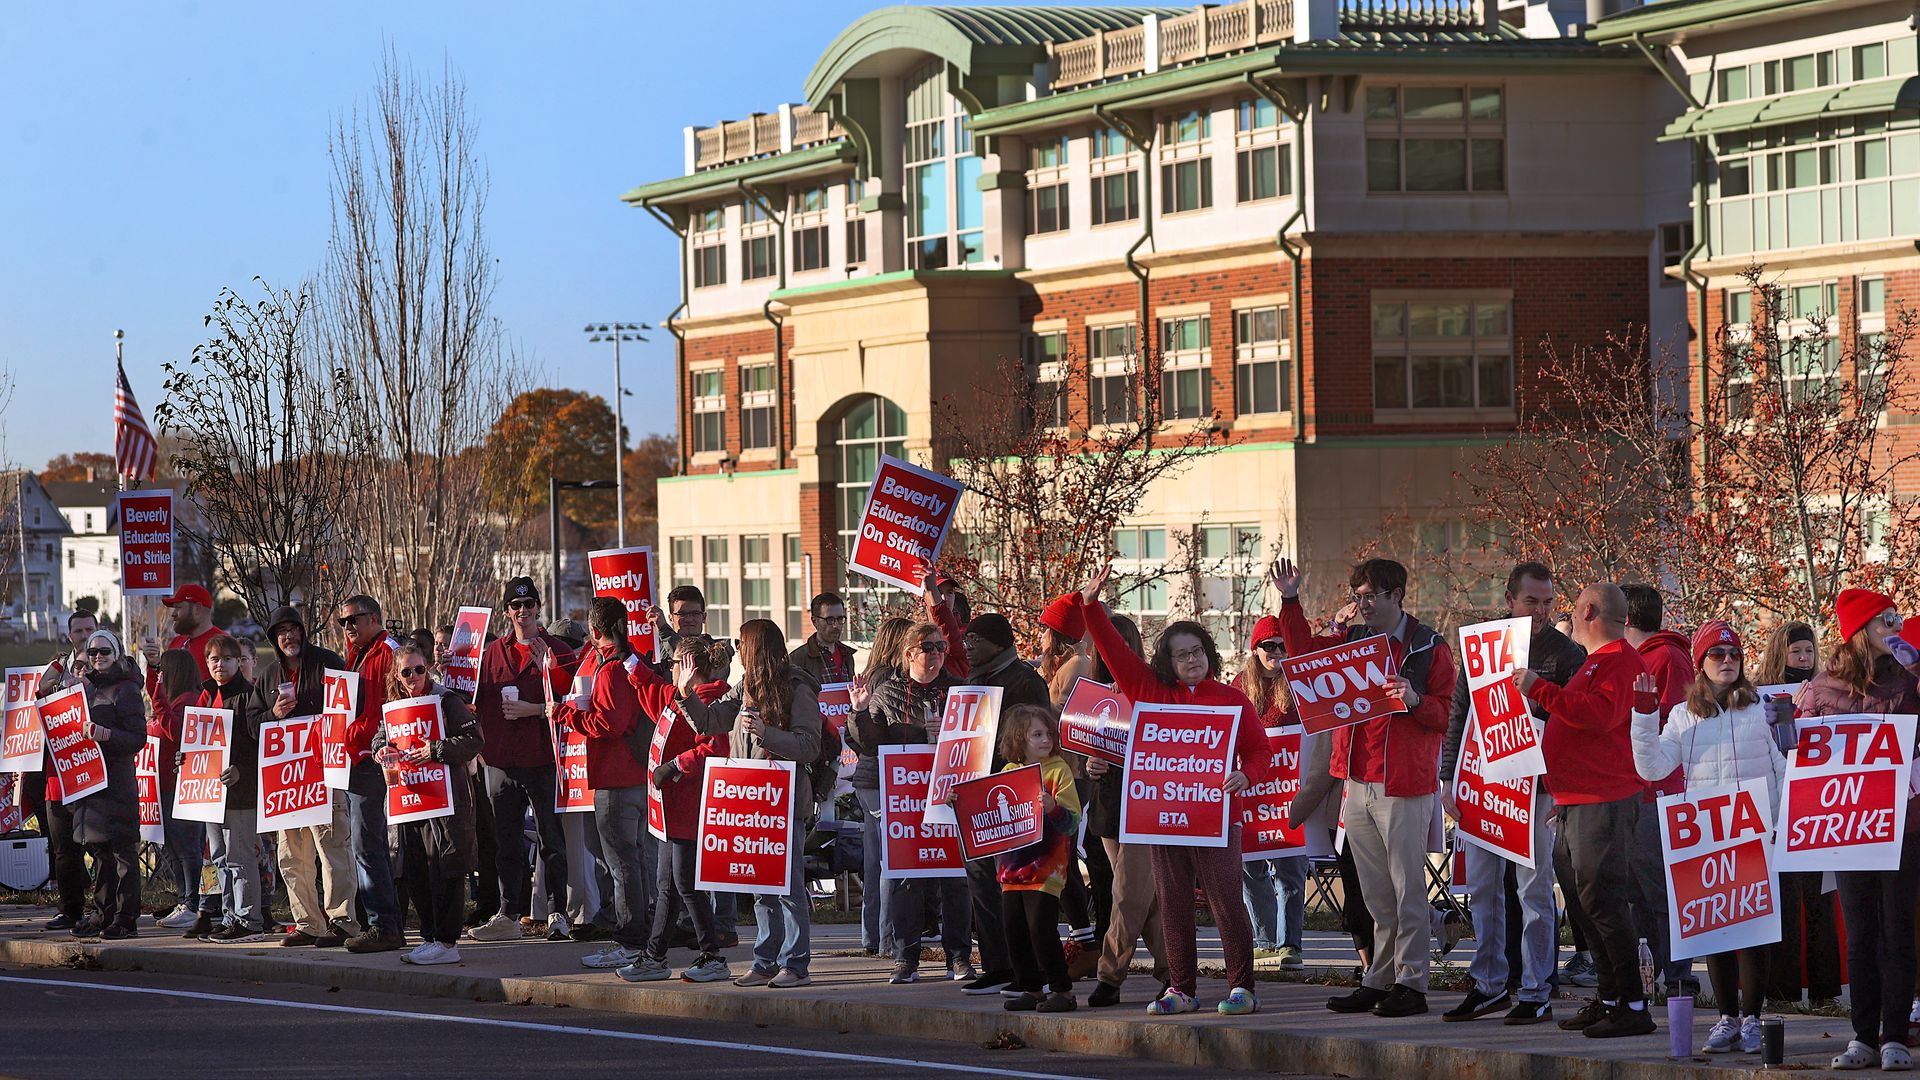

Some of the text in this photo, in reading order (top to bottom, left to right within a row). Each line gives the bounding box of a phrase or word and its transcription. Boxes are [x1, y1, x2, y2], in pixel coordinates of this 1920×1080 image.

[881, 476, 948, 517] Beverly
[125, 507, 168, 525] Beverly
[869, 499, 940, 538] Educators
[124, 530, 170, 545] Educators
[863, 523, 931, 559] On Strike
[125, 550, 170, 565] On Strike
[880, 554, 902, 570] BTA
[143, 572, 158, 580] BTA
[595, 570, 643, 591] Beverly
[627, 620, 652, 636] ike
[452, 653, 478, 668] ducators
[1291, 643, 1380, 674] LIVING WAGE
[1464, 628, 1519, 678] BTA
[326, 675, 351, 710] TA
[445, 674, 476, 691] On Strike
[1290, 656, 1390, 706] NOW
[819, 702, 852, 717] Beve
[1488, 682, 1509, 717] ON
[15, 709, 31, 730] ON
[45, 705, 81, 731] Beverly
[943, 694, 991, 731] BTA
[184, 713, 226, 747] BTA
[387, 717, 432, 740] Beverly
[1071, 728, 1105, 748] EDUCATORS
[1142, 723, 1224, 749] Beverly
[1484, 713, 1532, 758] STRIKE
[4, 730, 41, 755] STRIKE
[50, 730, 82, 753] Educato
[1795, 723, 1904, 768] BTA
[58, 745, 100, 773] On Strike
[192, 753, 209, 774] ON
[949, 740, 971, 768] ON
[1132, 751, 1224, 774] Educators
[76, 771, 90, 784] BTA
[281, 759, 306, 785] ON
[400, 766, 444, 787] Strike
[571, 763, 587, 779] Stri
[180, 779, 220, 801] STRIKE
[265, 781, 325, 815] STRIKE
[569, 788, 582, 798] BTA
[713, 779, 783, 807] Beverly
[1130, 780, 1222, 803] On Strike
[1241, 777, 1301, 798] ucator
[1821, 775, 1864, 808] ON
[401, 794, 421, 805] BTA
[1257, 801, 1292, 821] Stri
[1458, 781, 1528, 824] On Strike
[706, 807, 786, 829] Educators
[971, 801, 1034, 830] NORTH SHORE
[1159, 811, 1189, 825] BTA
[1666, 790, 1767, 851] BTA
[889, 821, 915, 839] On
[976, 818, 1035, 843] EDUCATORS UNITED
[1257, 829, 1285, 842] BTA
[1480, 818, 1504, 839] BTA
[1789, 808, 1894, 847] STRIKE
[704, 834, 785, 856] On Strike
[919, 848, 947, 860] BTA
[729, 862, 756, 875] BTA
[1701, 850, 1737, 889] ON
[1682, 880, 1768, 933] STRIKE
